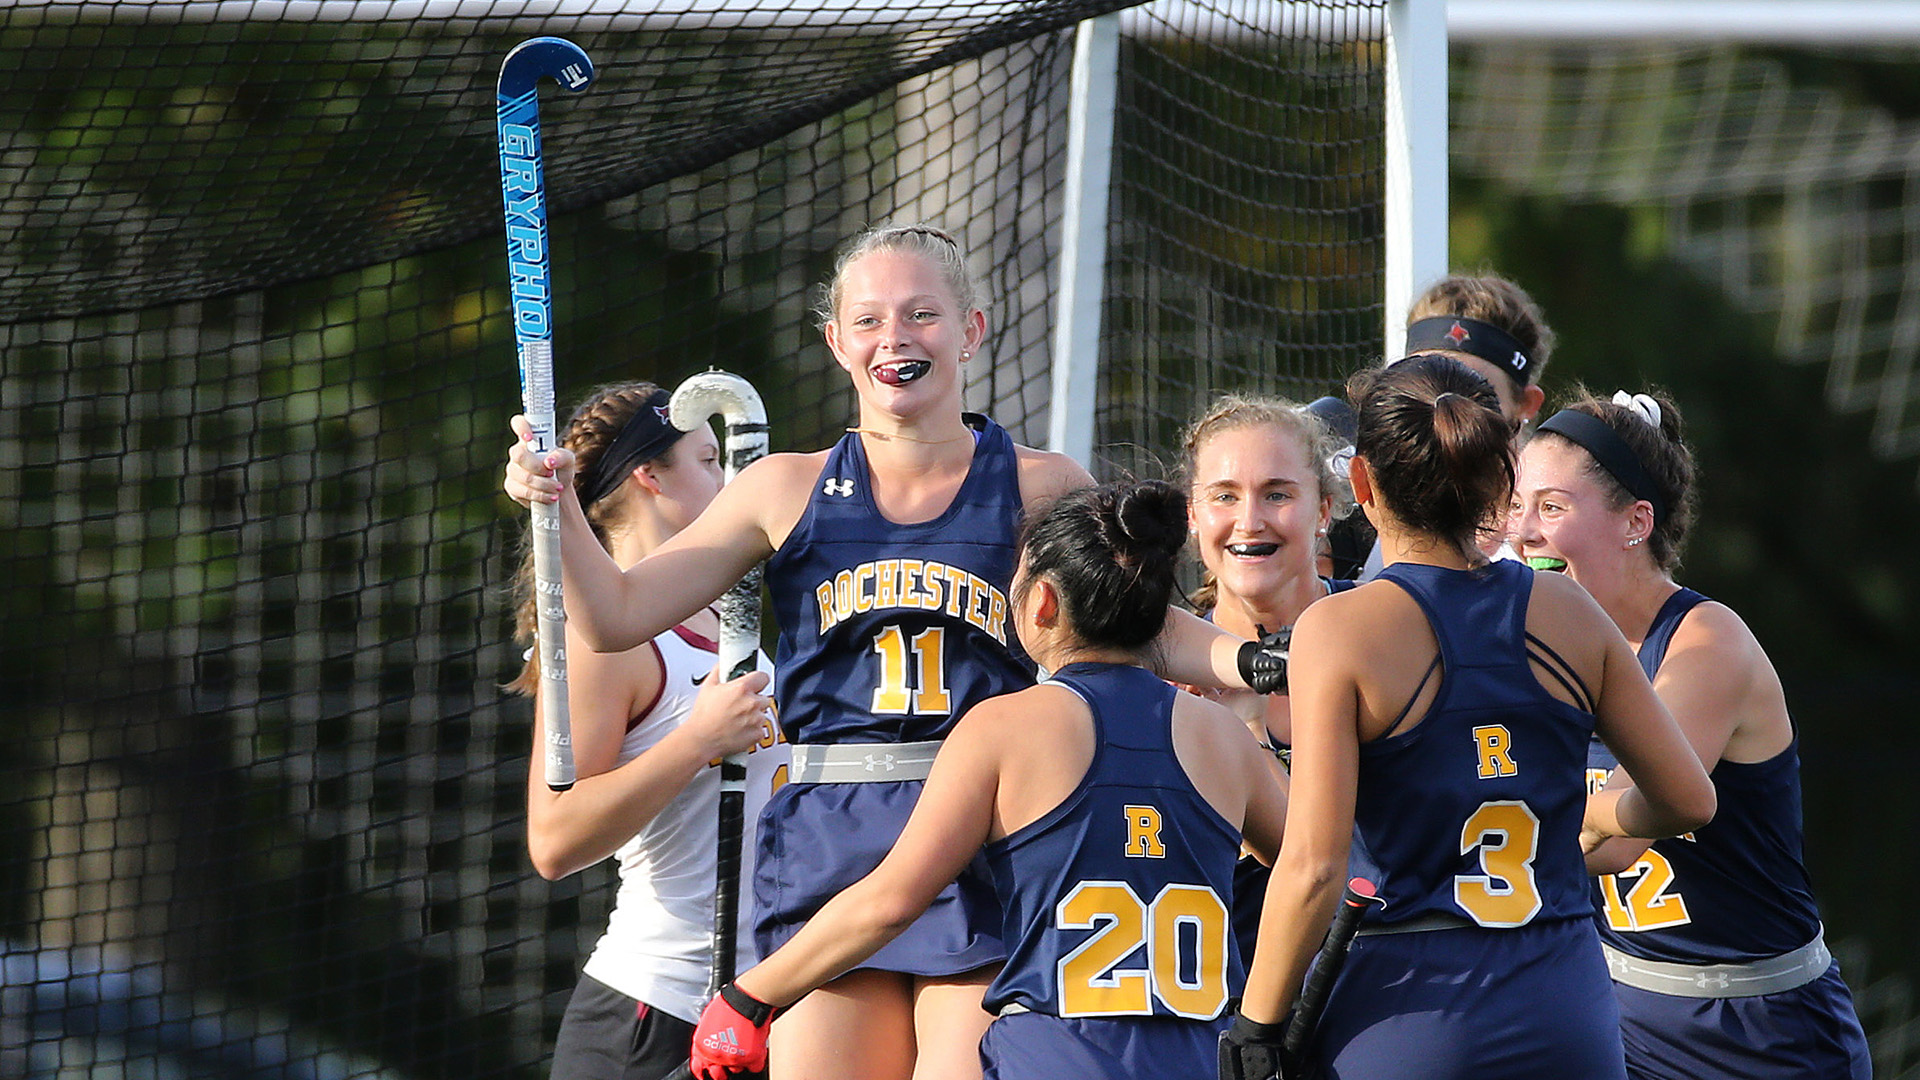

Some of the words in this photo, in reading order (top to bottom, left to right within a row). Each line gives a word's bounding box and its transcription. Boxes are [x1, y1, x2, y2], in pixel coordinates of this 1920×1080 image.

[502, 123, 553, 344] GRYPHO
[816, 558, 1008, 648] ROCHESTER
[871, 624, 952, 716] 11
[1472, 724, 1518, 780] R
[1124, 804, 1166, 859] R
[1454, 799, 1543, 929] 3
[1598, 847, 1692, 932] 12
[1056, 880, 1229, 1021] 20
[703, 1038, 745, 1056] adidas
